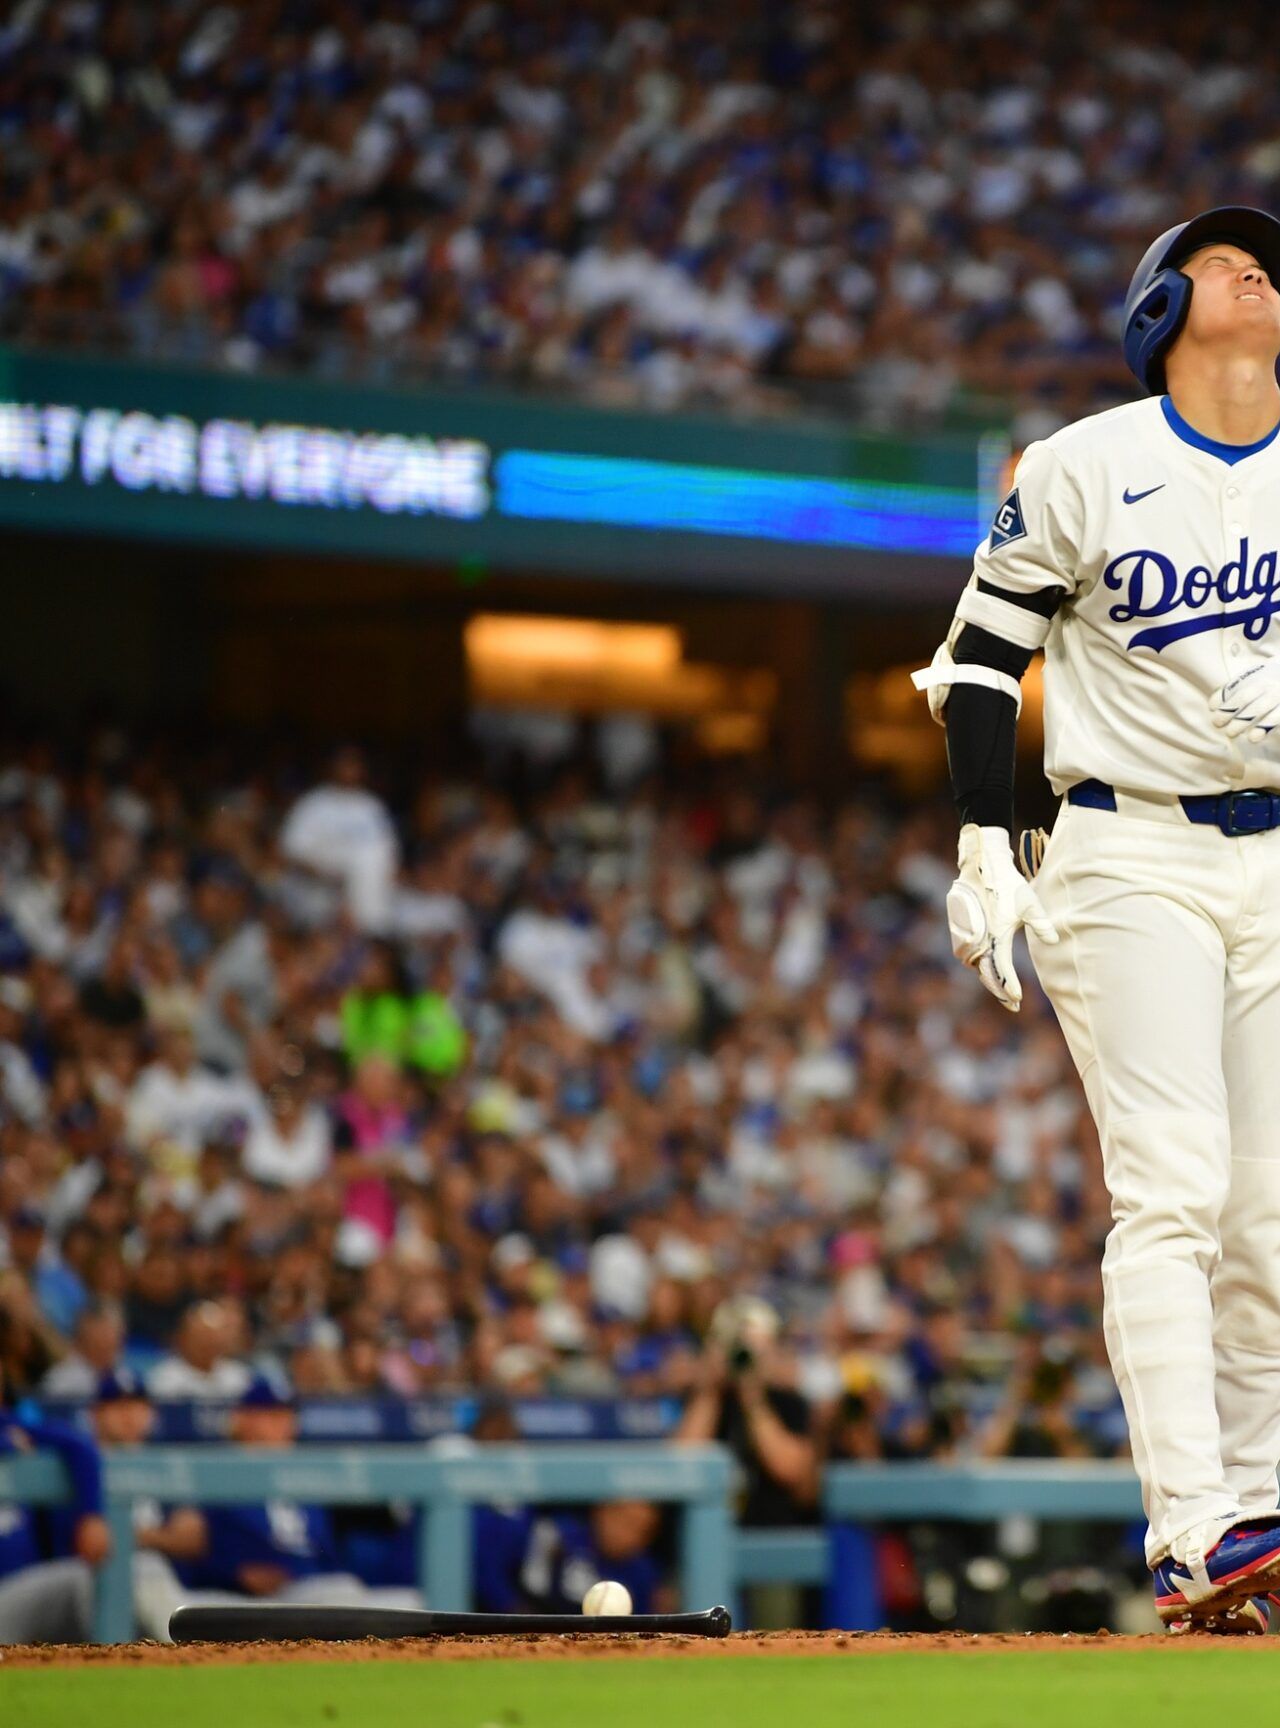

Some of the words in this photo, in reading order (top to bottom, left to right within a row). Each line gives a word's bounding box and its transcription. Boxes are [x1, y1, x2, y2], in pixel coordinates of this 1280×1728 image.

[83, 408, 196, 494] FOR
[202, 417, 490, 520] EVERYONE
[998, 504, 1017, 531] G
